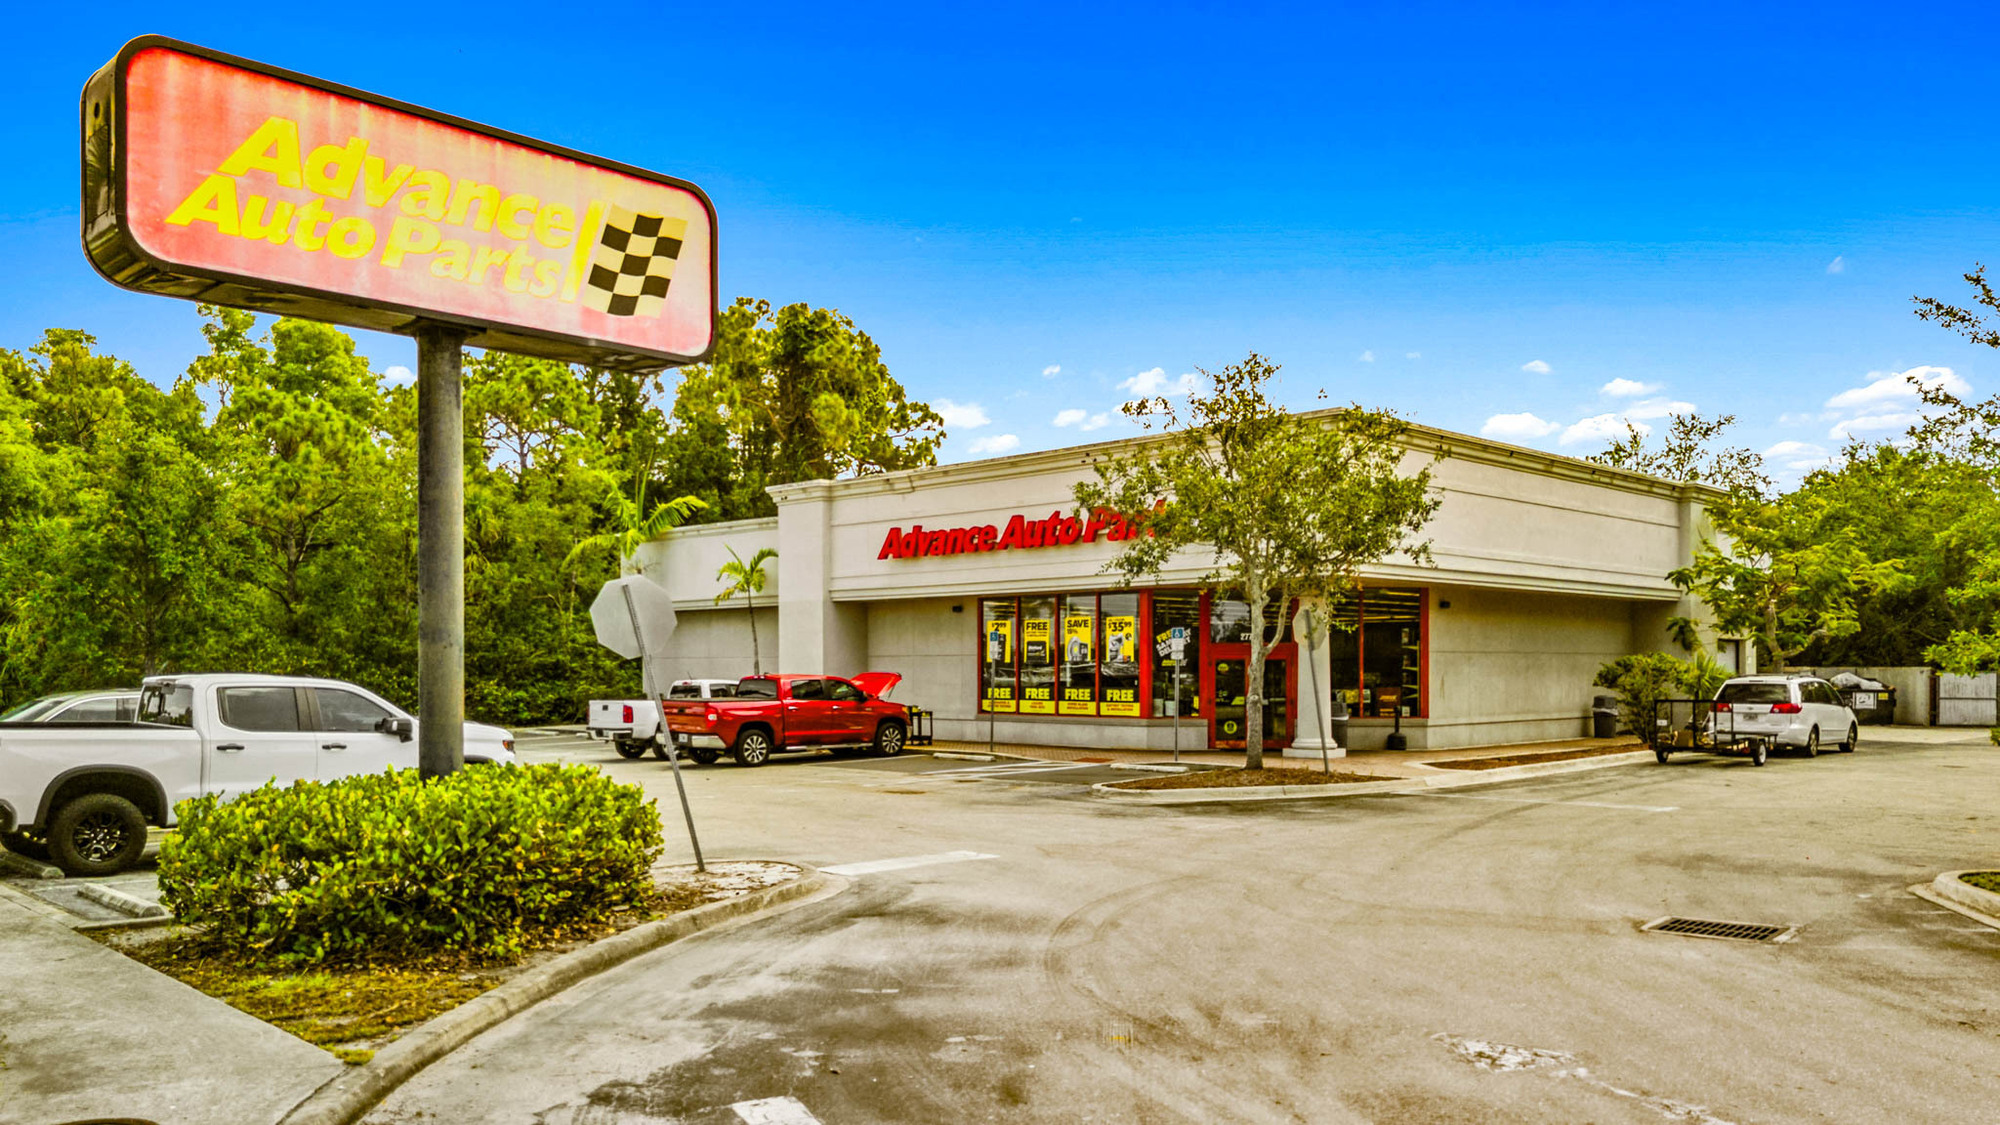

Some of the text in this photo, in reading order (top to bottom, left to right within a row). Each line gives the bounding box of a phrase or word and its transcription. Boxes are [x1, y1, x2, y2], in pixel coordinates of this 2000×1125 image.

[217, 116, 576, 249] Advance
[165, 173, 562, 299] Auto Parts
[877, 525, 998, 560] Advance
[997, 510, 1083, 550] Auto
[1026, 622, 1048, 631] FREE
[1067, 619, 1089, 628] SAVE
[987, 687, 1011, 698] FREE
[1025, 687, 1050, 699] FREE
[1065, 688, 1091, 700] FREE
[1106, 689, 1134, 701] FREE
